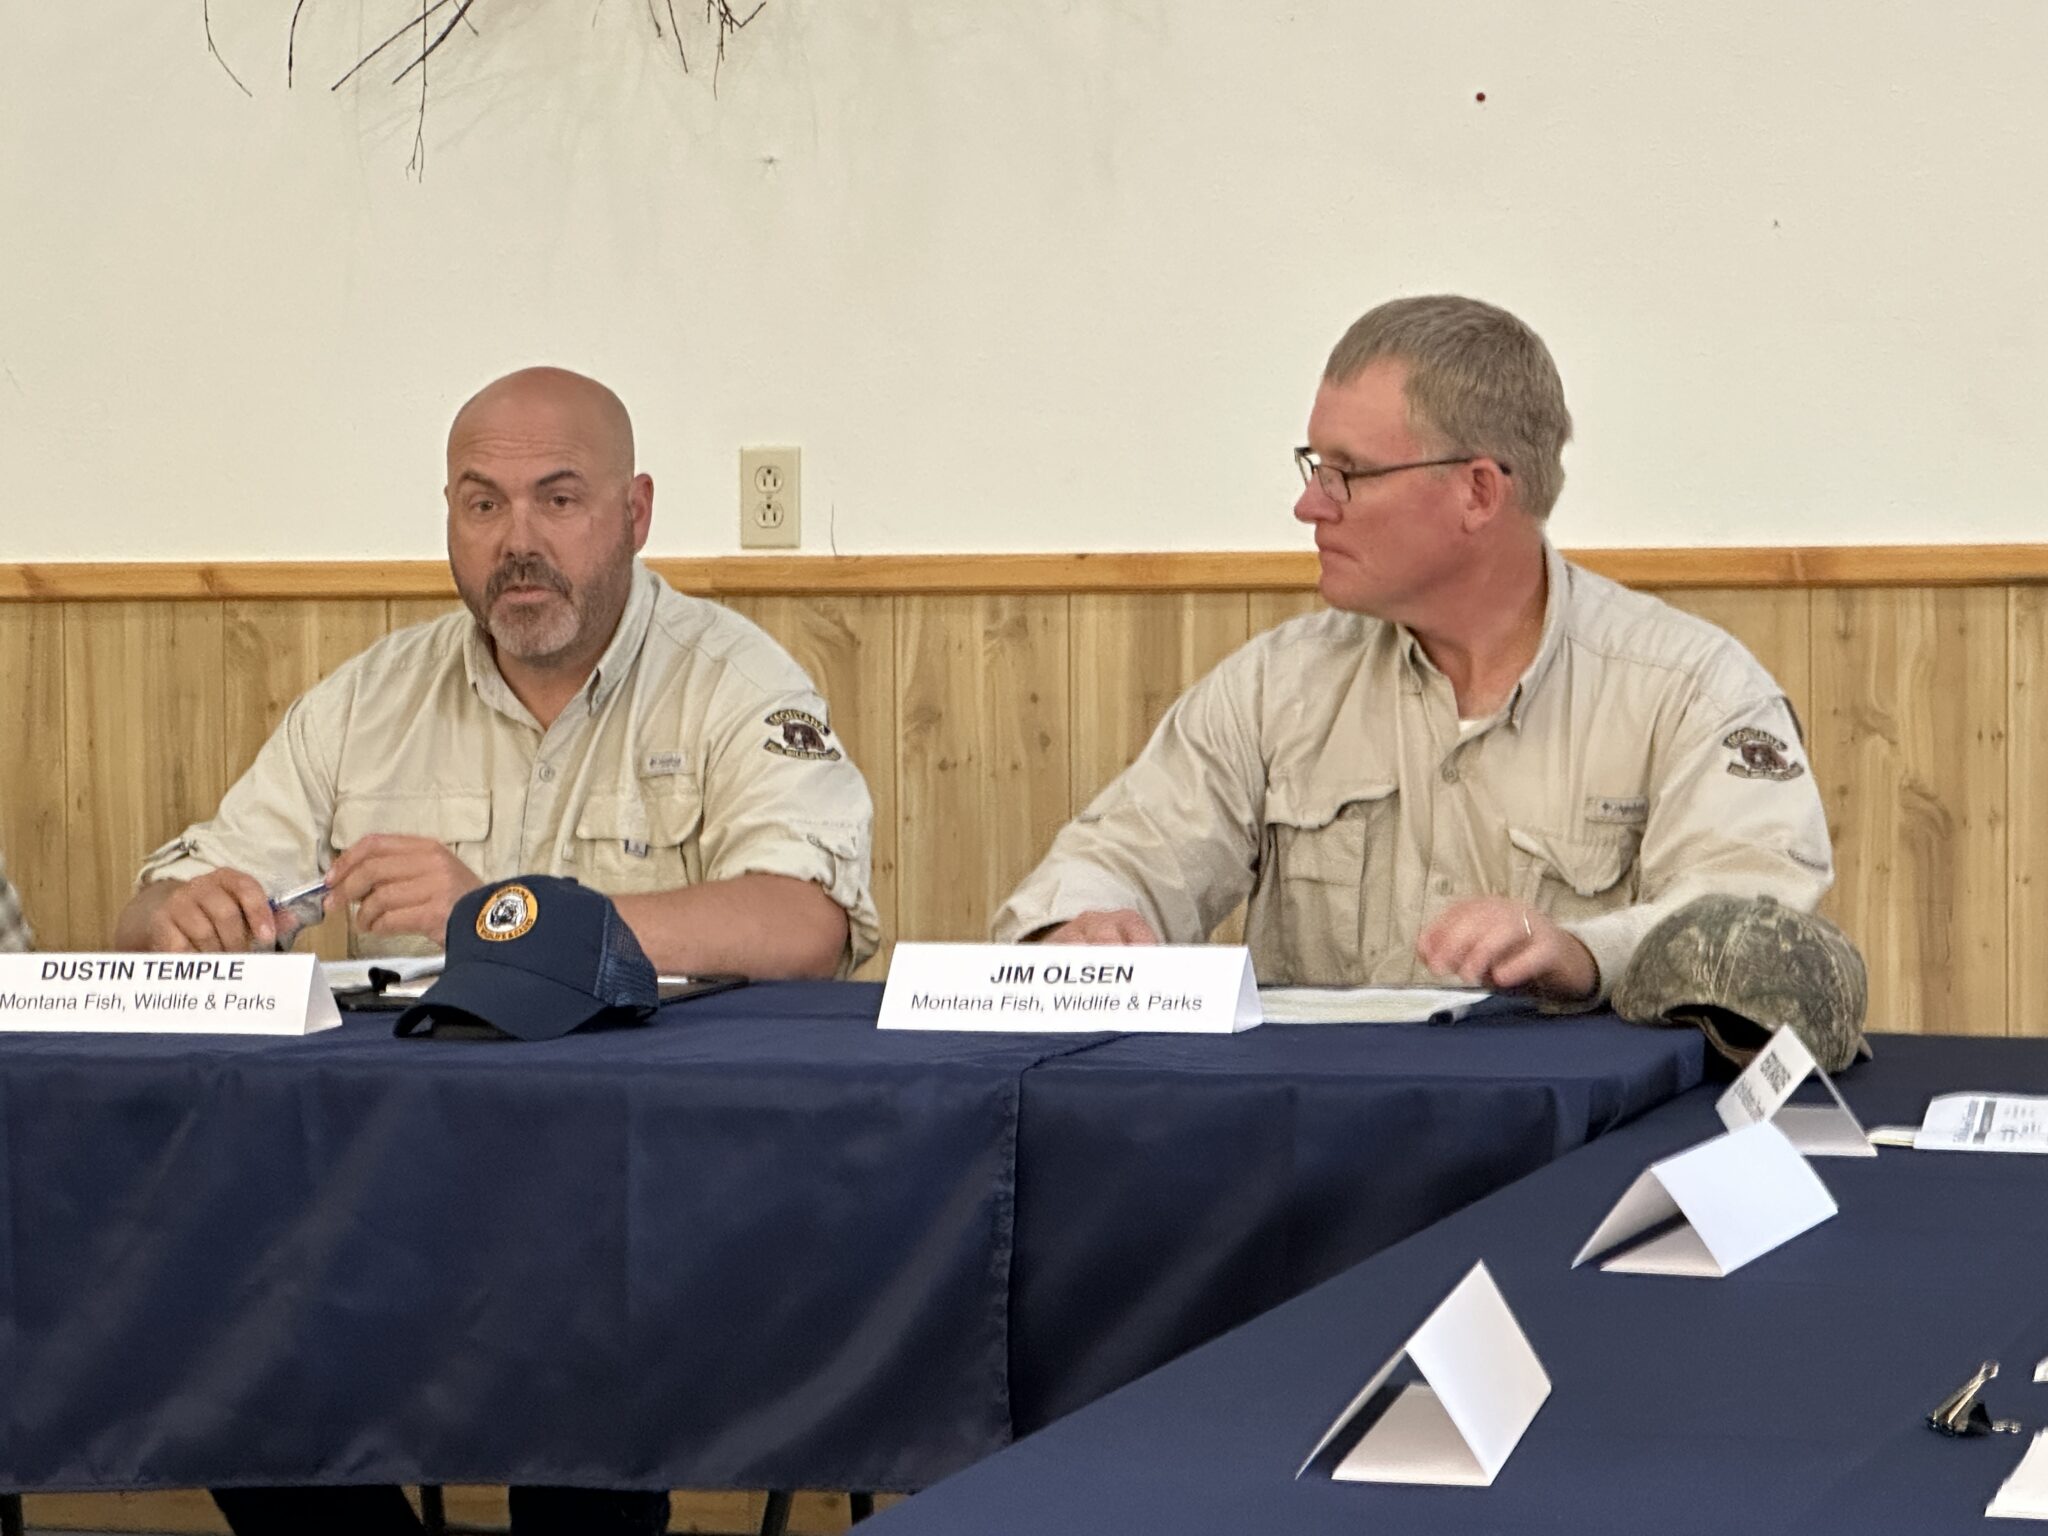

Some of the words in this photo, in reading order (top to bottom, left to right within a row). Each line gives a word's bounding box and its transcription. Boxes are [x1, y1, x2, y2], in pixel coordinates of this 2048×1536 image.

[41, 960, 136, 981] DUSTIN
[143, 960, 245, 981] TEMPLE
[989, 965, 1036, 985] JIM
[1042, 965, 1135, 985] OLSEN
[0, 992, 77, 1010] Montana
[84, 992, 126, 1012] Fish,
[134, 992, 199, 1010] Wildlife
[204, 993, 216, 1010] &
[224, 993, 276, 1010] Parks
[911, 993, 993, 1011] Montana
[1000, 995, 1044, 1013] Fish,
[1053, 995, 1121, 1011] Wildlife
[1126, 995, 1140, 1011] &
[1147, 994, 1203, 1011] Parks
